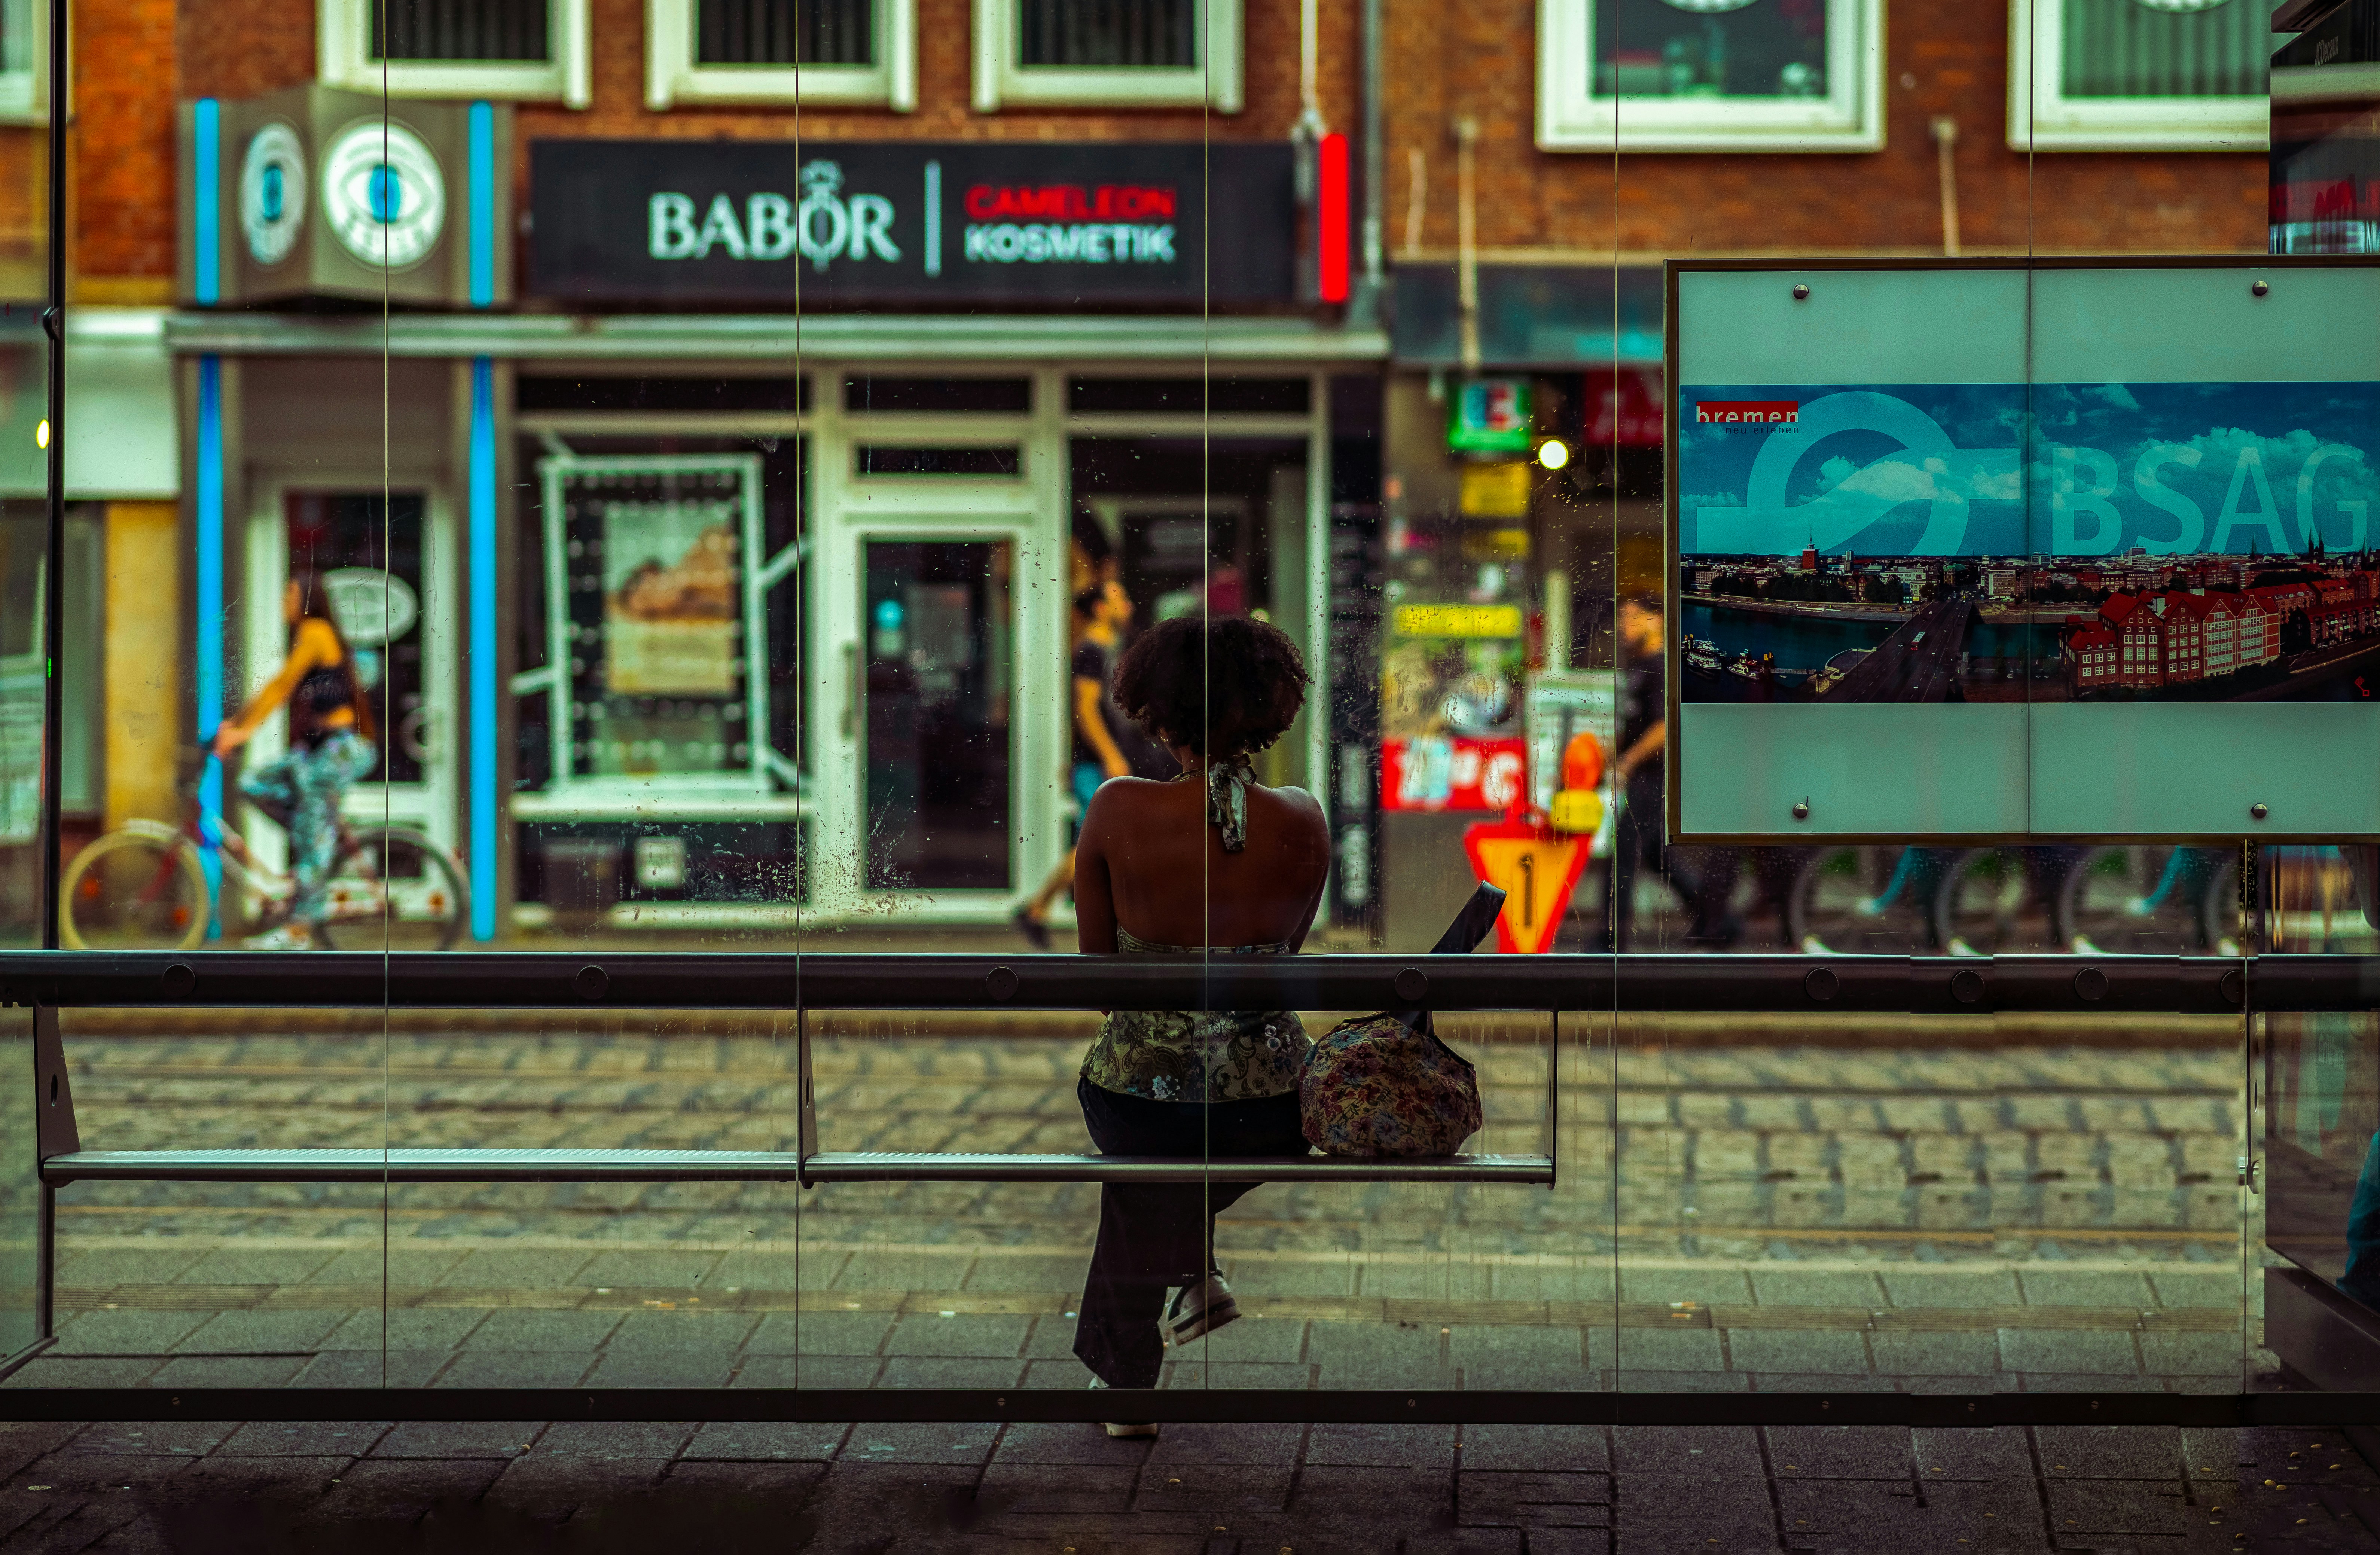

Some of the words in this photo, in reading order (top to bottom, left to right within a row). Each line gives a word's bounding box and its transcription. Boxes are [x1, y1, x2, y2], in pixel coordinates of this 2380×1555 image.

[2315, 35, 2338, 69] JCDecaux
[965, 224, 1175, 261] KOSMETIK
[1696, 405, 1798, 422] bremen
[1754, 425, 1799, 434] erleben
[2052, 444, 2367, 555] BSAG
